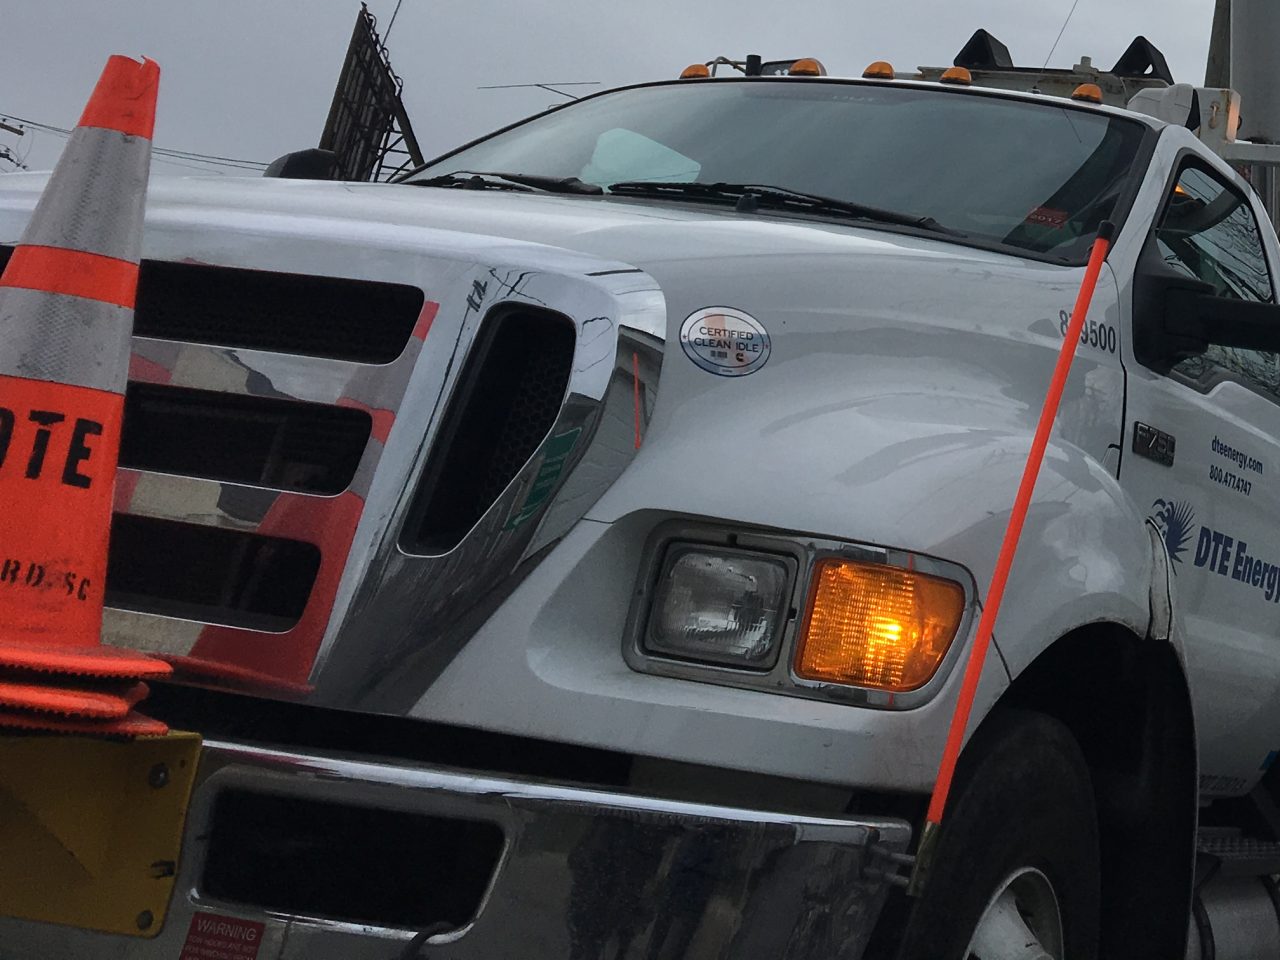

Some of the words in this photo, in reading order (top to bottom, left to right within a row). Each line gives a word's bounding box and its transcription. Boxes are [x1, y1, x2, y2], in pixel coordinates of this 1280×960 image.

[693, 337, 732, 350] CLEAN
[735, 341, 759, 353] IDLE
[699, 326, 754, 341] CERTIFIED
[1059, 309, 1116, 354] 89500
[1211, 435, 1263, 475] dteenergy.com
[1209, 464, 1252, 496] 800.477.4747
[1193, 526, 1234, 576] DTE
[197, 919, 257, 941] WARNING
